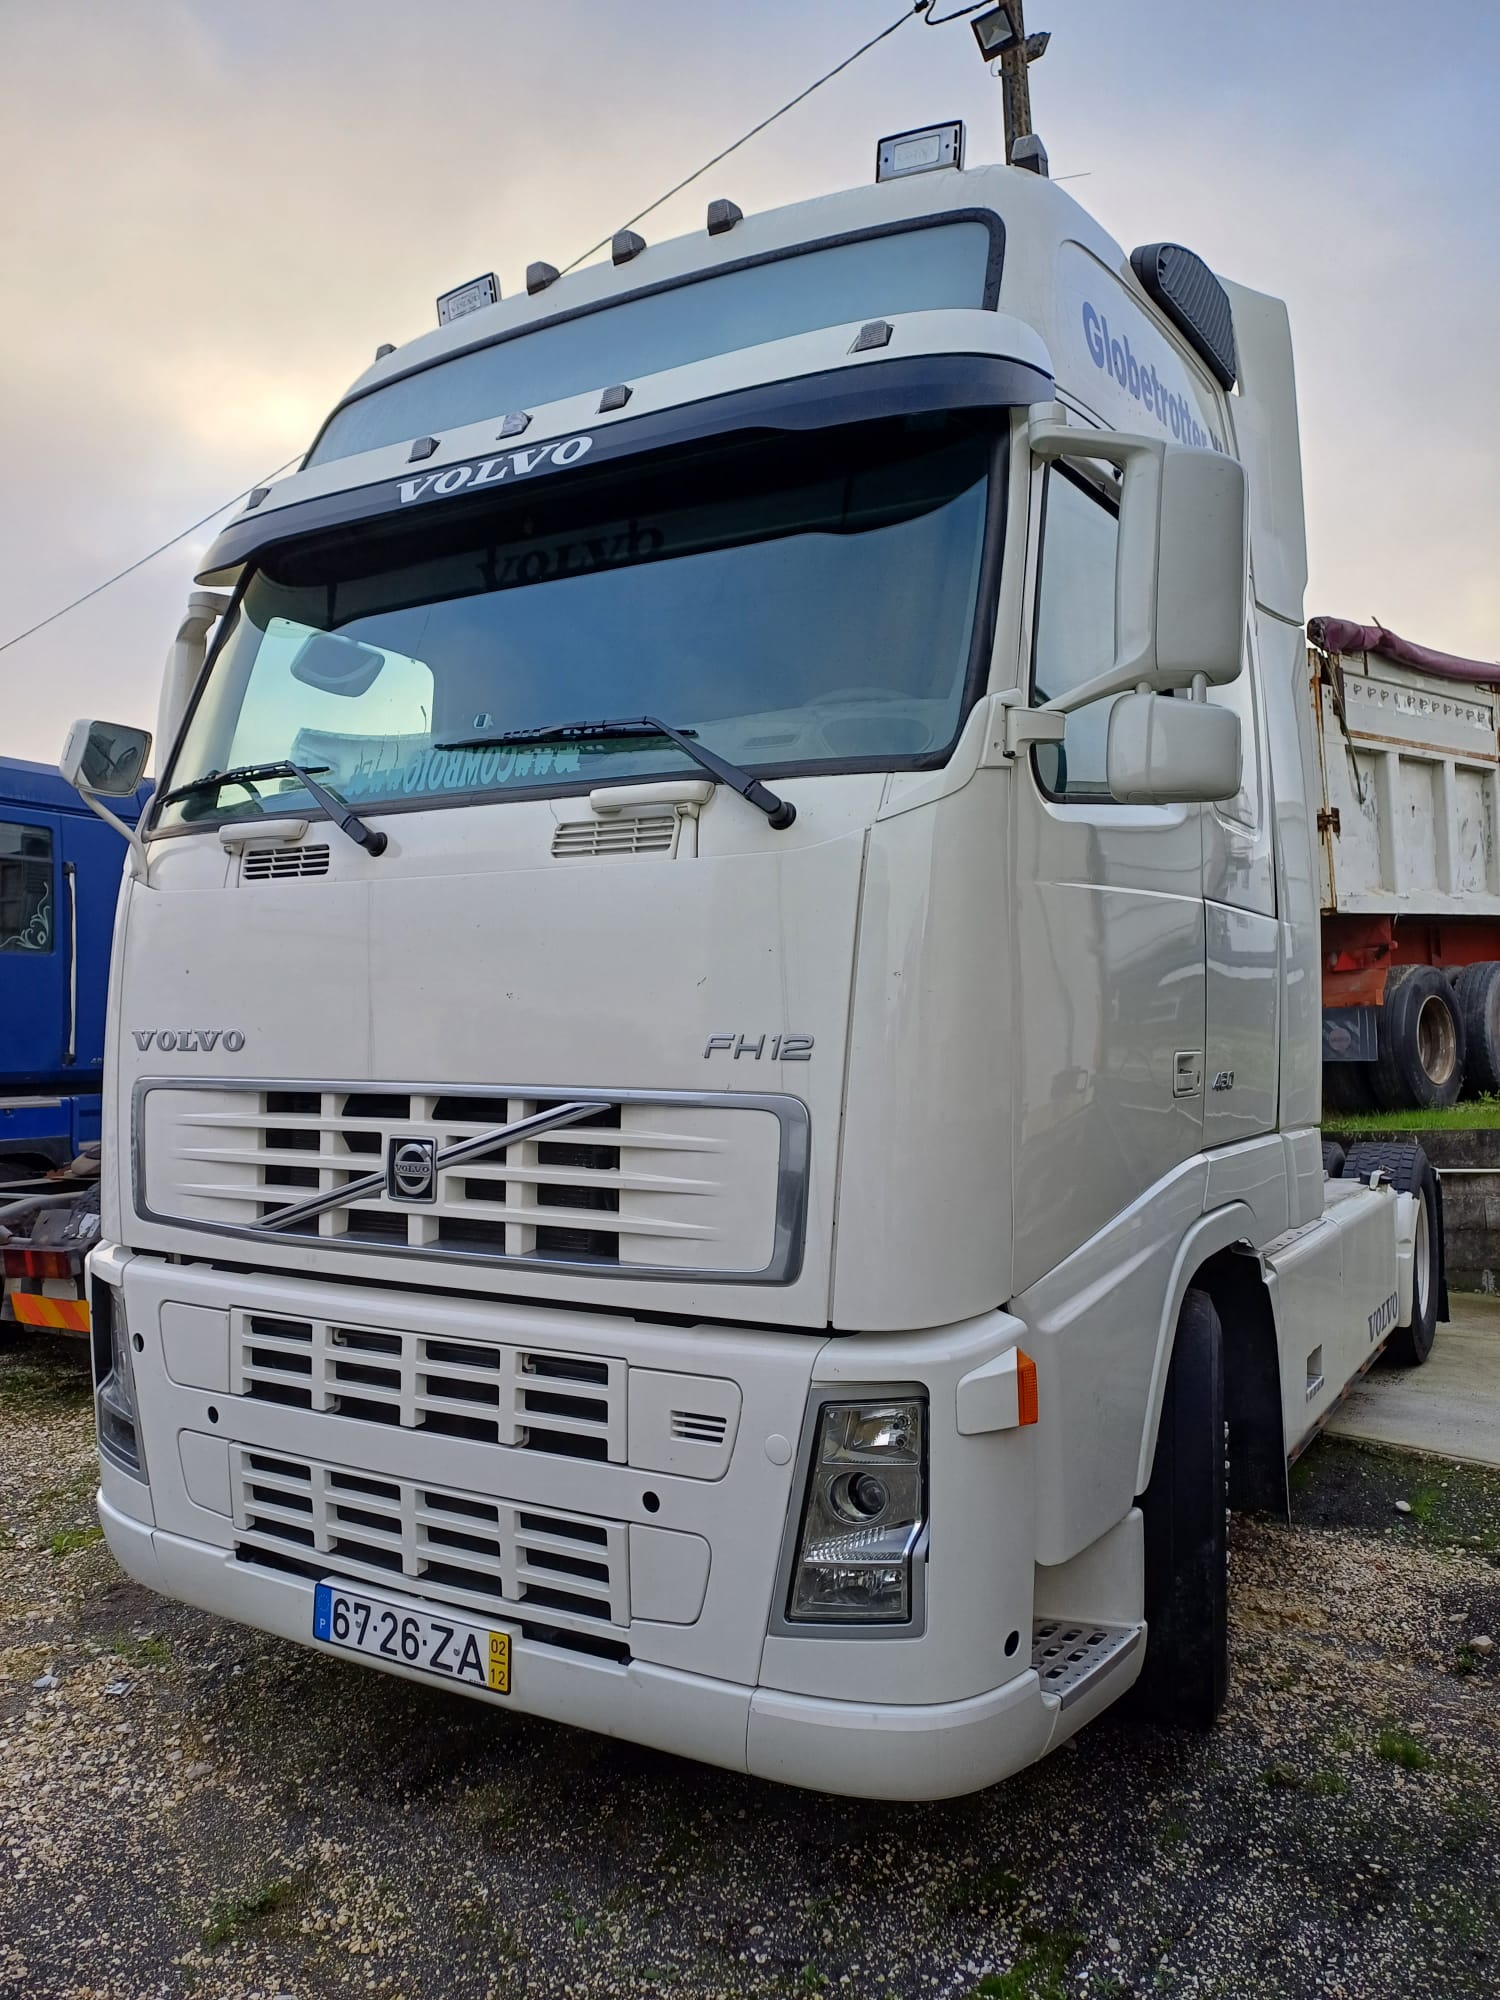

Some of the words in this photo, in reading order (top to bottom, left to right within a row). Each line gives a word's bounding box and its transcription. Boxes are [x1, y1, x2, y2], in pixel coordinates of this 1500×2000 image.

[396, 436, 593, 504] VOLVO
[131, 1029, 246, 1052] VOLVO
[703, 1032, 815, 1061] FH12
[395, 1163, 430, 1174] VOLVO
[1367, 1290, 1398, 1343] VOLVO
[319, 1618, 326, 1629] P
[490, 1638, 506, 1656] 02
[490, 1668, 506, 1686] 12
